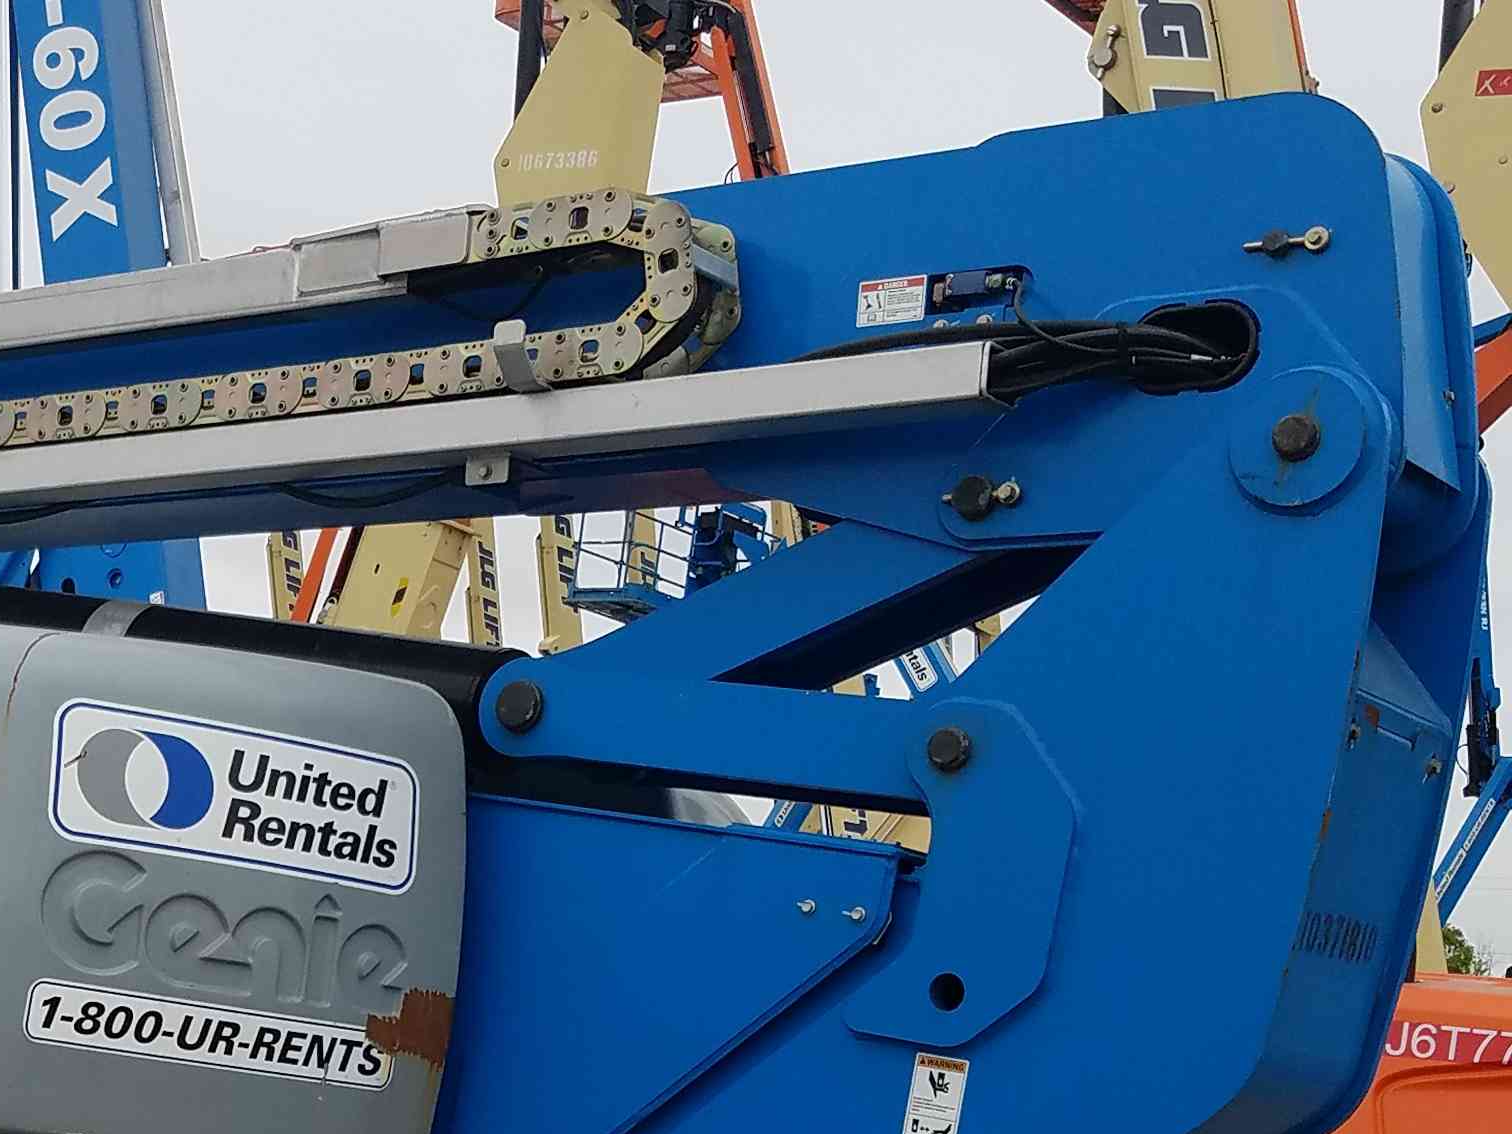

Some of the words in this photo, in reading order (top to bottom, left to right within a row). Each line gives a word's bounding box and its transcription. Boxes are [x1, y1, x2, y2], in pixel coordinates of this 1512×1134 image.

[517, 150, 598, 172] 10673386
[478, 541, 496, 591] JLG
[905, 651, 927, 681] tals
[227, 748, 388, 819] United
[221, 799, 397, 869] Rentals
[41, 849, 409, 1010] Genie
[40, 996, 383, 1076] 1-800-UR-RENTS
[927, 1057, 964, 1072] WARNING
